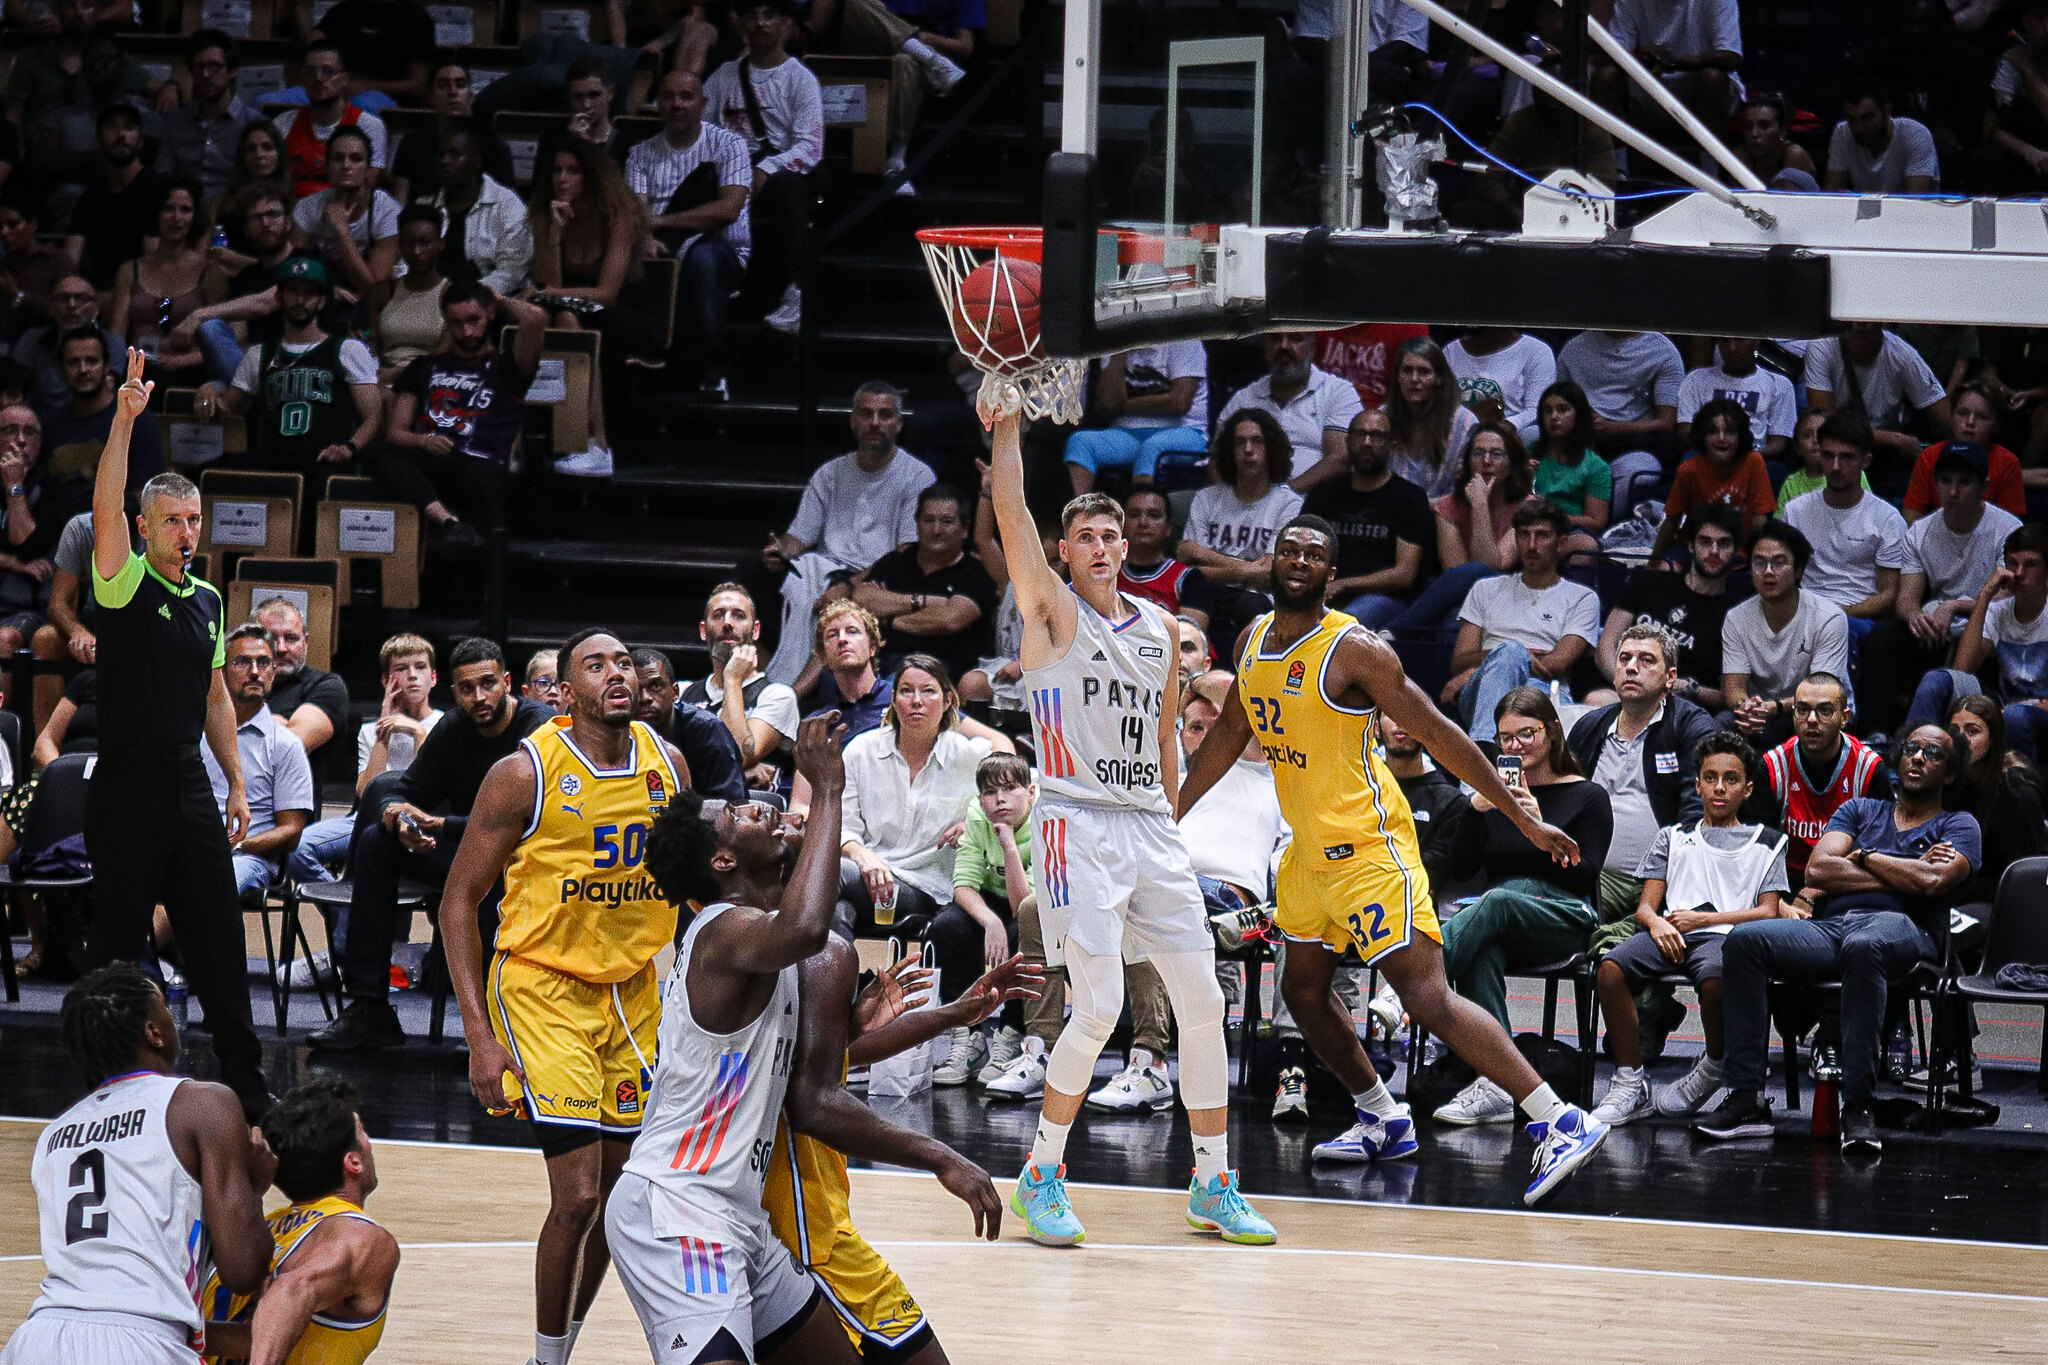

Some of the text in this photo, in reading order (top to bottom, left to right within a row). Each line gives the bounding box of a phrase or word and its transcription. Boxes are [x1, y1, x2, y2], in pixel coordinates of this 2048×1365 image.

[280, 401, 312, 437] 0
[1331, 521, 1389, 540] LLISTER
[1120, 715, 1144, 755] 14
[1249, 696, 1285, 735] 32
[593, 822, 648, 869] 50
[1787, 816, 1828, 839] ROCK
[1347, 902, 1392, 951] 32
[563, 1096, 599, 1111] Rapyd
[45, 1108, 147, 1158] MALWAYA
[65, 1147, 109, 1246] 2
